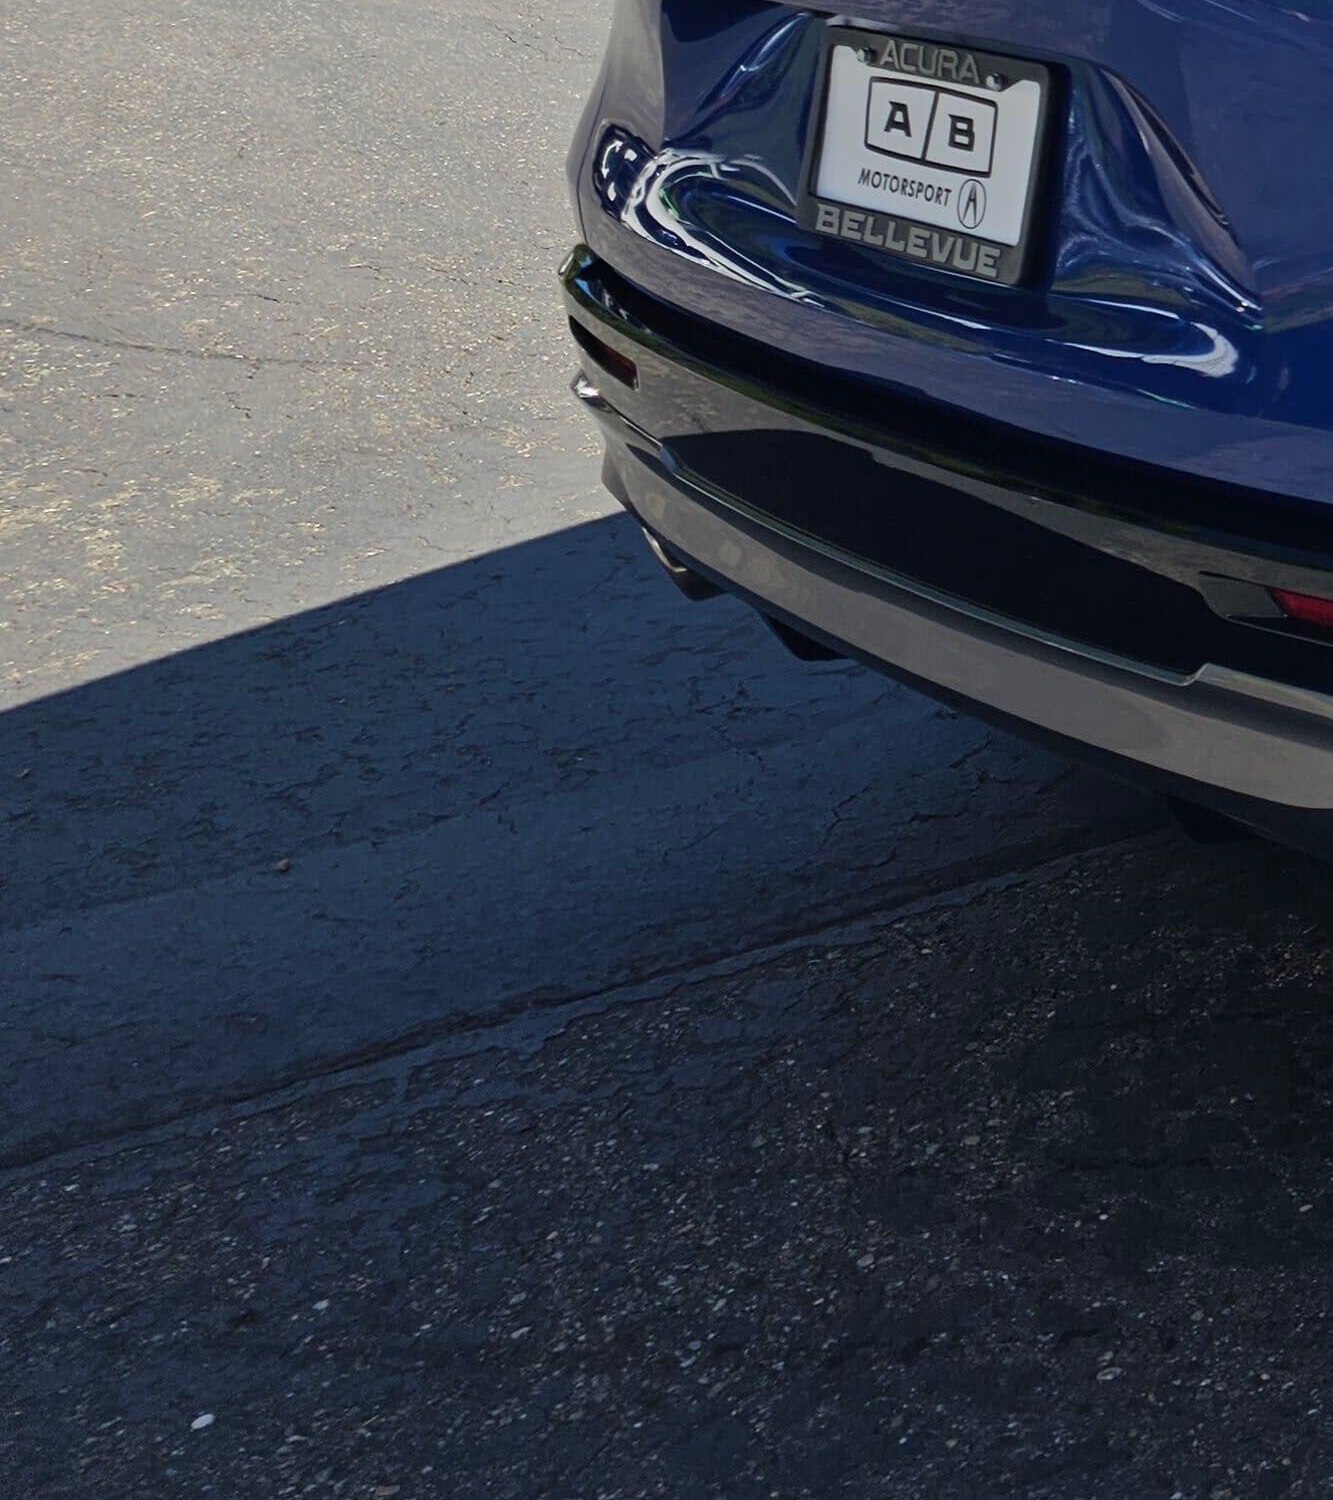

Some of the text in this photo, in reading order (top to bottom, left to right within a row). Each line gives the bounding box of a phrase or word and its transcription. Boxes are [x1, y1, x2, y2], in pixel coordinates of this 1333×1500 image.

[880, 40, 980, 84] ACURA
[884, 100, 975, 151] A B
[858, 168, 952, 207] MOTORSPORT
[815, 203, 1000, 278] BELLEVUE
